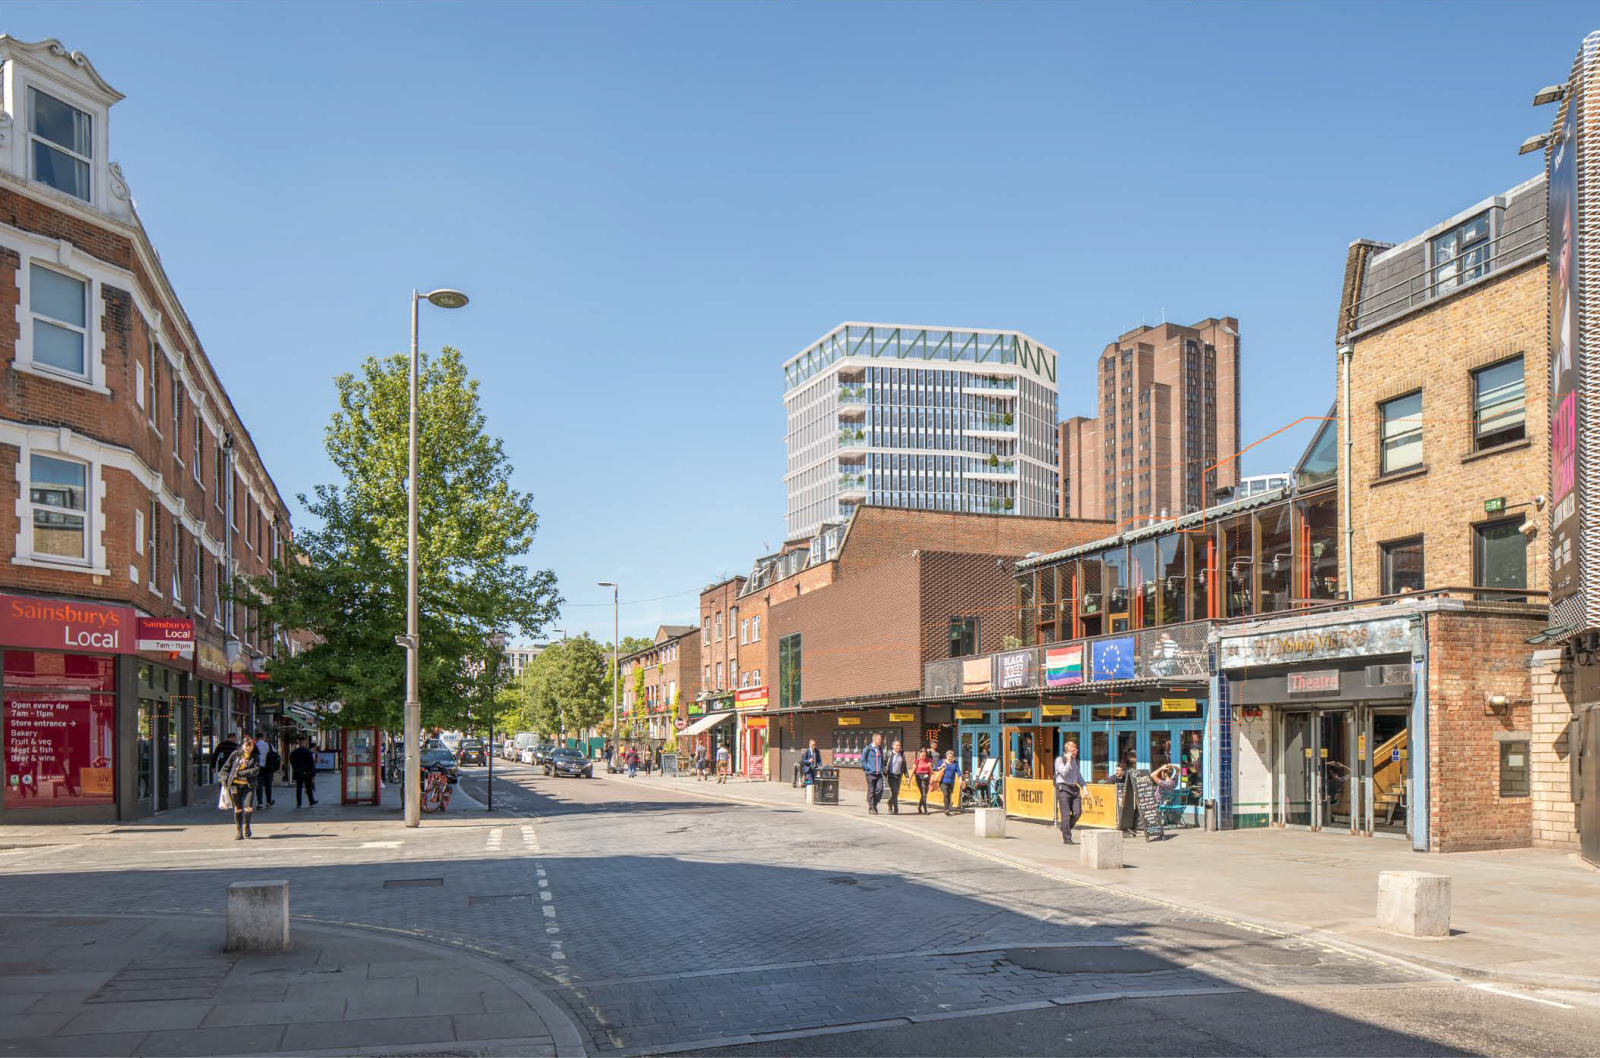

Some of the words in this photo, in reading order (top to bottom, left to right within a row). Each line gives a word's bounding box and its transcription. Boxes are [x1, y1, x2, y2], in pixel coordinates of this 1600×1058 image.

[12, 600, 120, 628] Sainsbury's
[143, 620, 191, 630] Sainsbury's
[65, 626, 119, 649] Local
[165, 629, 190, 638] Local
[175, 642, 191, 650] 11pm
[1278, 635, 1314, 654] Young
[1004, 653, 1024, 666] BLACK
[1004, 678, 1023, 688] TTER
[1291, 674, 1338, 690] Theatre
[11, 701, 31, 709] Open
[33, 702, 54, 710] every
[56, 702, 69, 710] day
[11, 719, 32, 727] Store
[11, 729, 38, 737] Bakery
[1093, 795, 1104, 808] Vic
